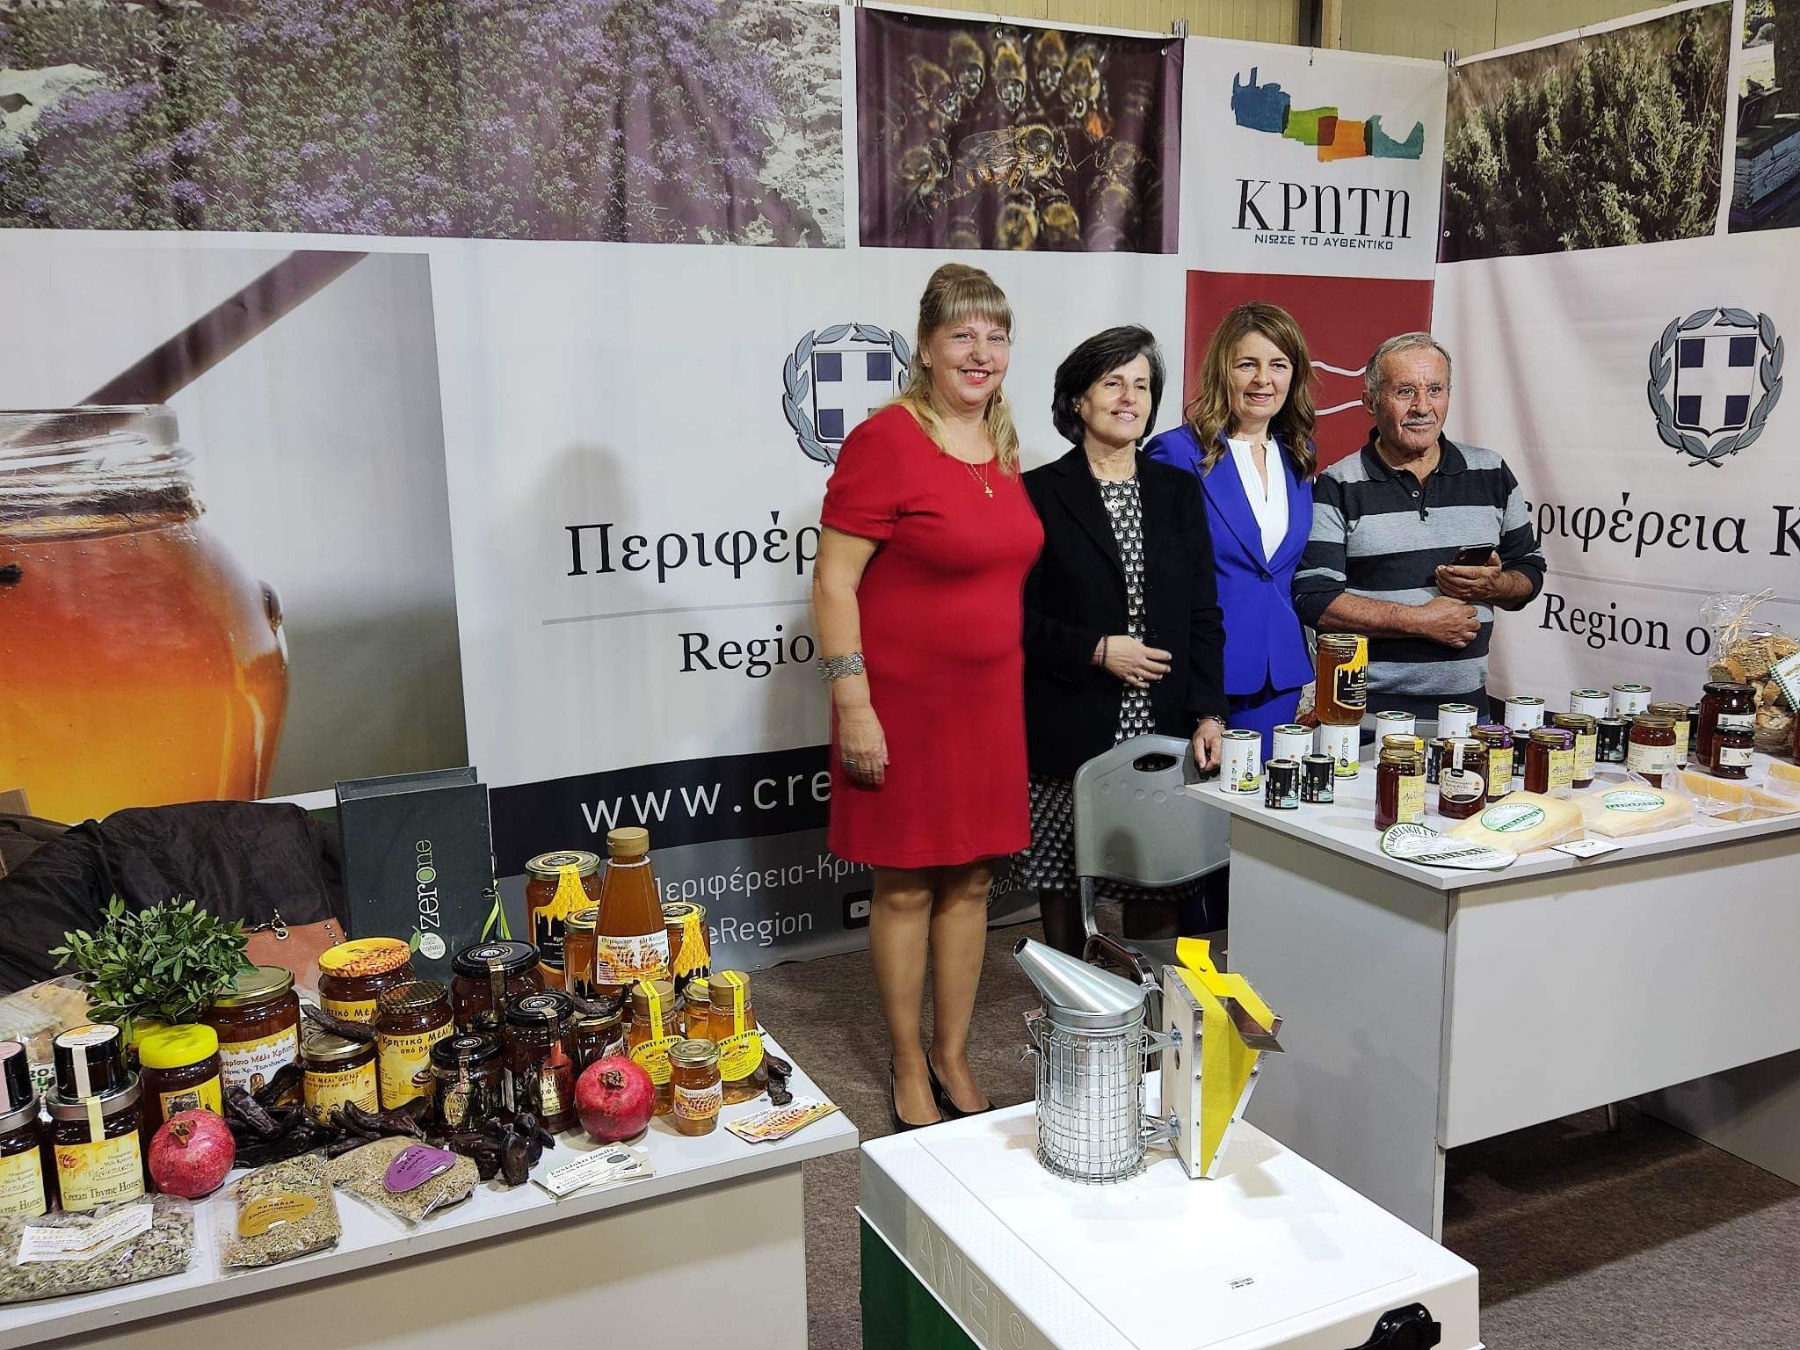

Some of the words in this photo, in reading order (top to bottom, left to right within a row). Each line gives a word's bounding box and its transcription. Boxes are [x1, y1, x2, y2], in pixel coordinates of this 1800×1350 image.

[1254, 233, 1296, 245] ΝΙΩΣΕ
[1301, 236, 1318, 246] ΤΟ
[1323, 237, 1393, 251] ΑΥΘΕΝΤΙΚΟ
[564, 510, 821, 584] Περιφέρ
[1525, 491, 1750, 558] ριφέρεια
[678, 624, 824, 679] Regio
[1538, 592, 1671, 650] Region
[1686, 626, 1716, 656] o
[580, 769, 832, 834] www.cre
[415, 839, 441, 930] zerone
[709, 911, 813, 947] eRegion
[90, 1187, 117, 1199] Thyme
[119, 1178, 142, 1193] Honey
